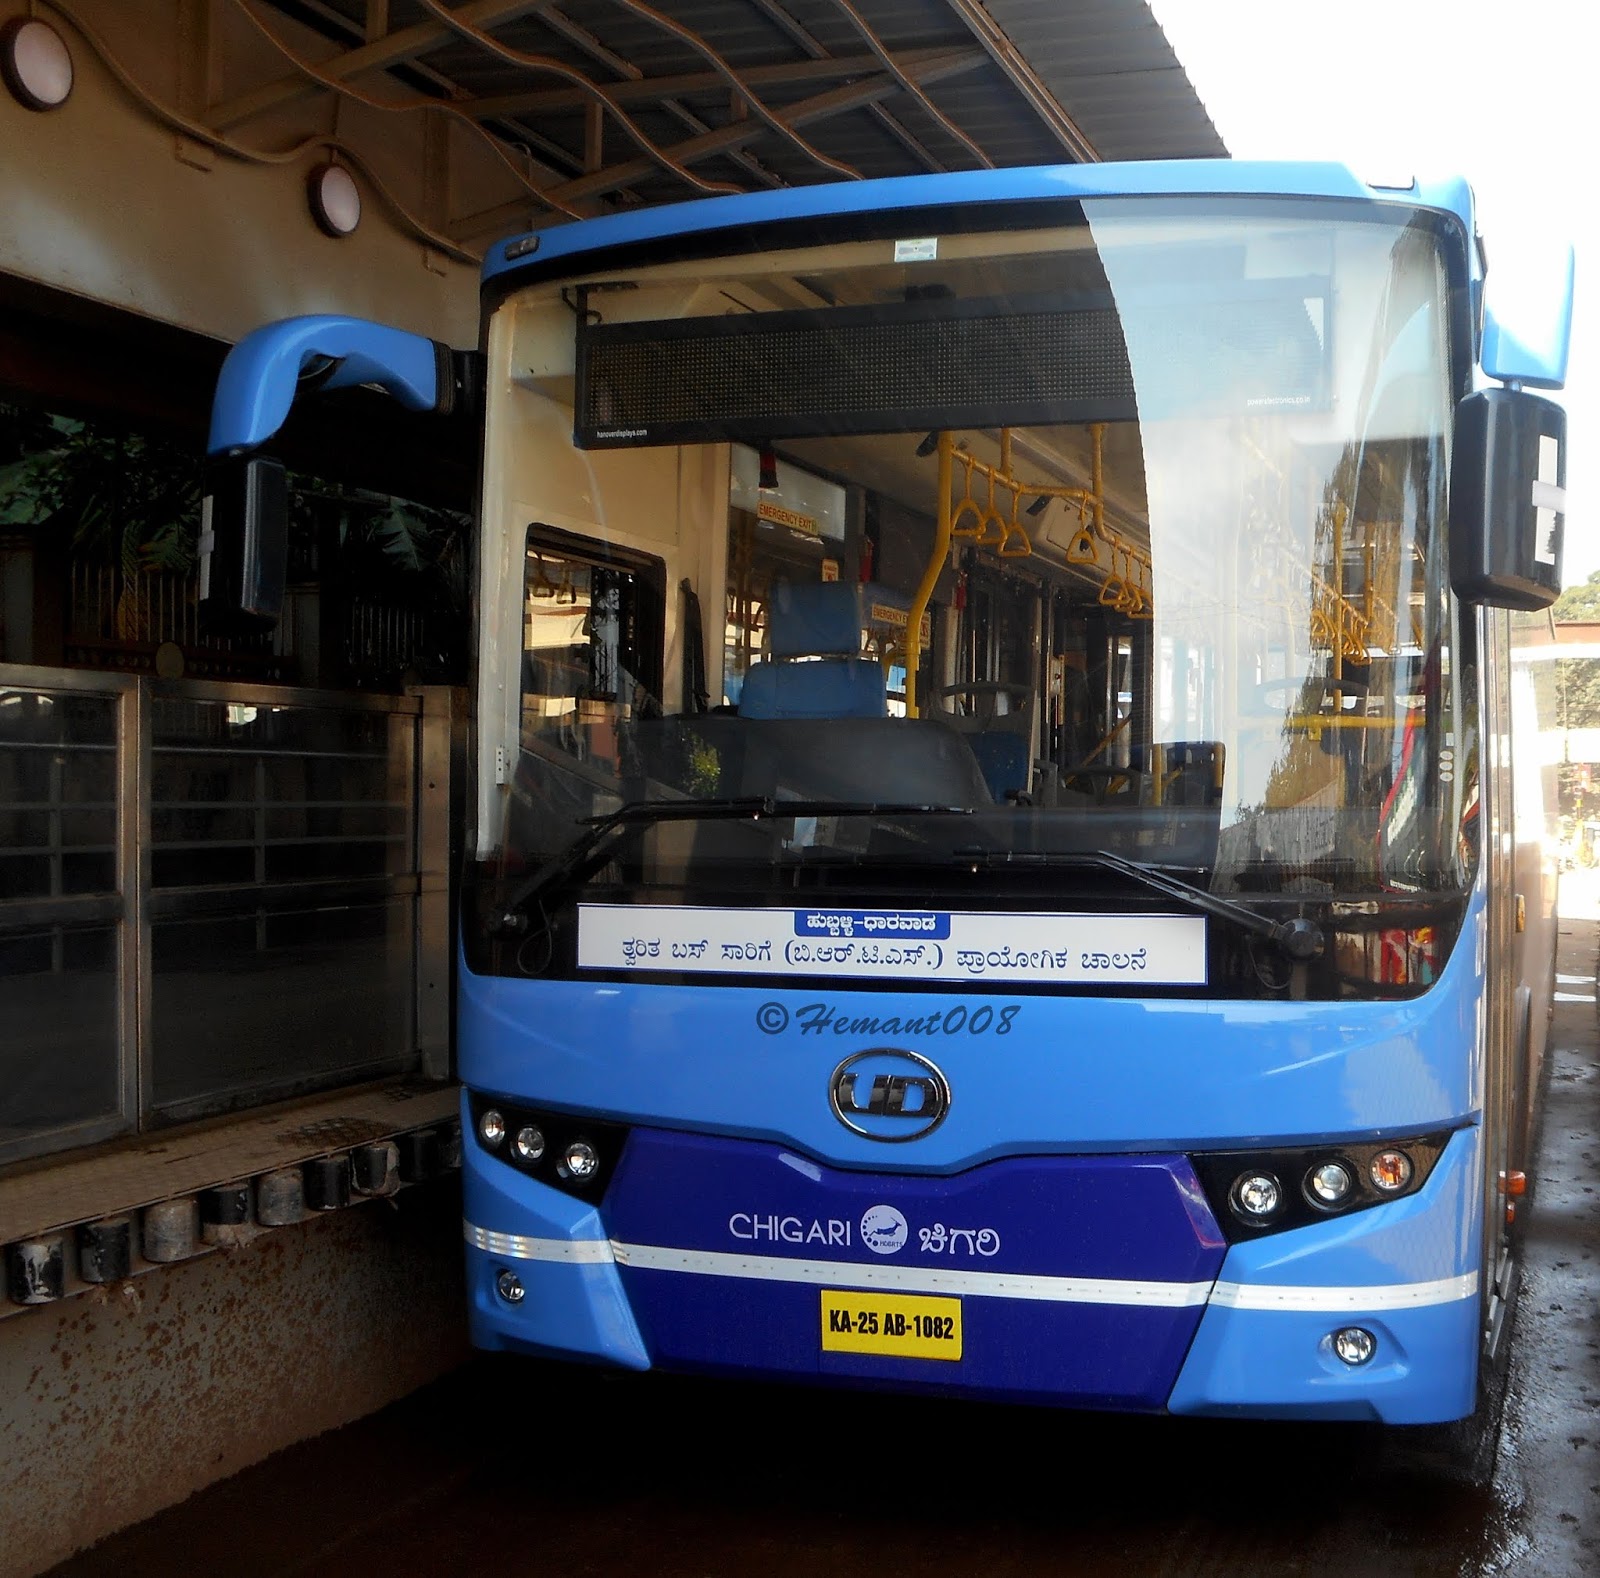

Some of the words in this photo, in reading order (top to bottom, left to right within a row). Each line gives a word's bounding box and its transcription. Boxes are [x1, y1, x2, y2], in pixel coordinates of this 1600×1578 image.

[759, 503, 798, 525] EMERGENCY
[798, 517, 812, 530] EXIT
[621, 936, 661, 967] ತ್ವರಿತ
[671, 939, 709, 959] ಬಸ್
[721, 939, 773, 962] ಸಾರಿಗೆ
[1080, 947, 1147, 971] ಚಾಲನೆ
[729, 1213, 850, 1246] CHIGARI
[830, 1309, 879, 1335] KA-25
[883, 1313, 954, 1340] AB-1082
